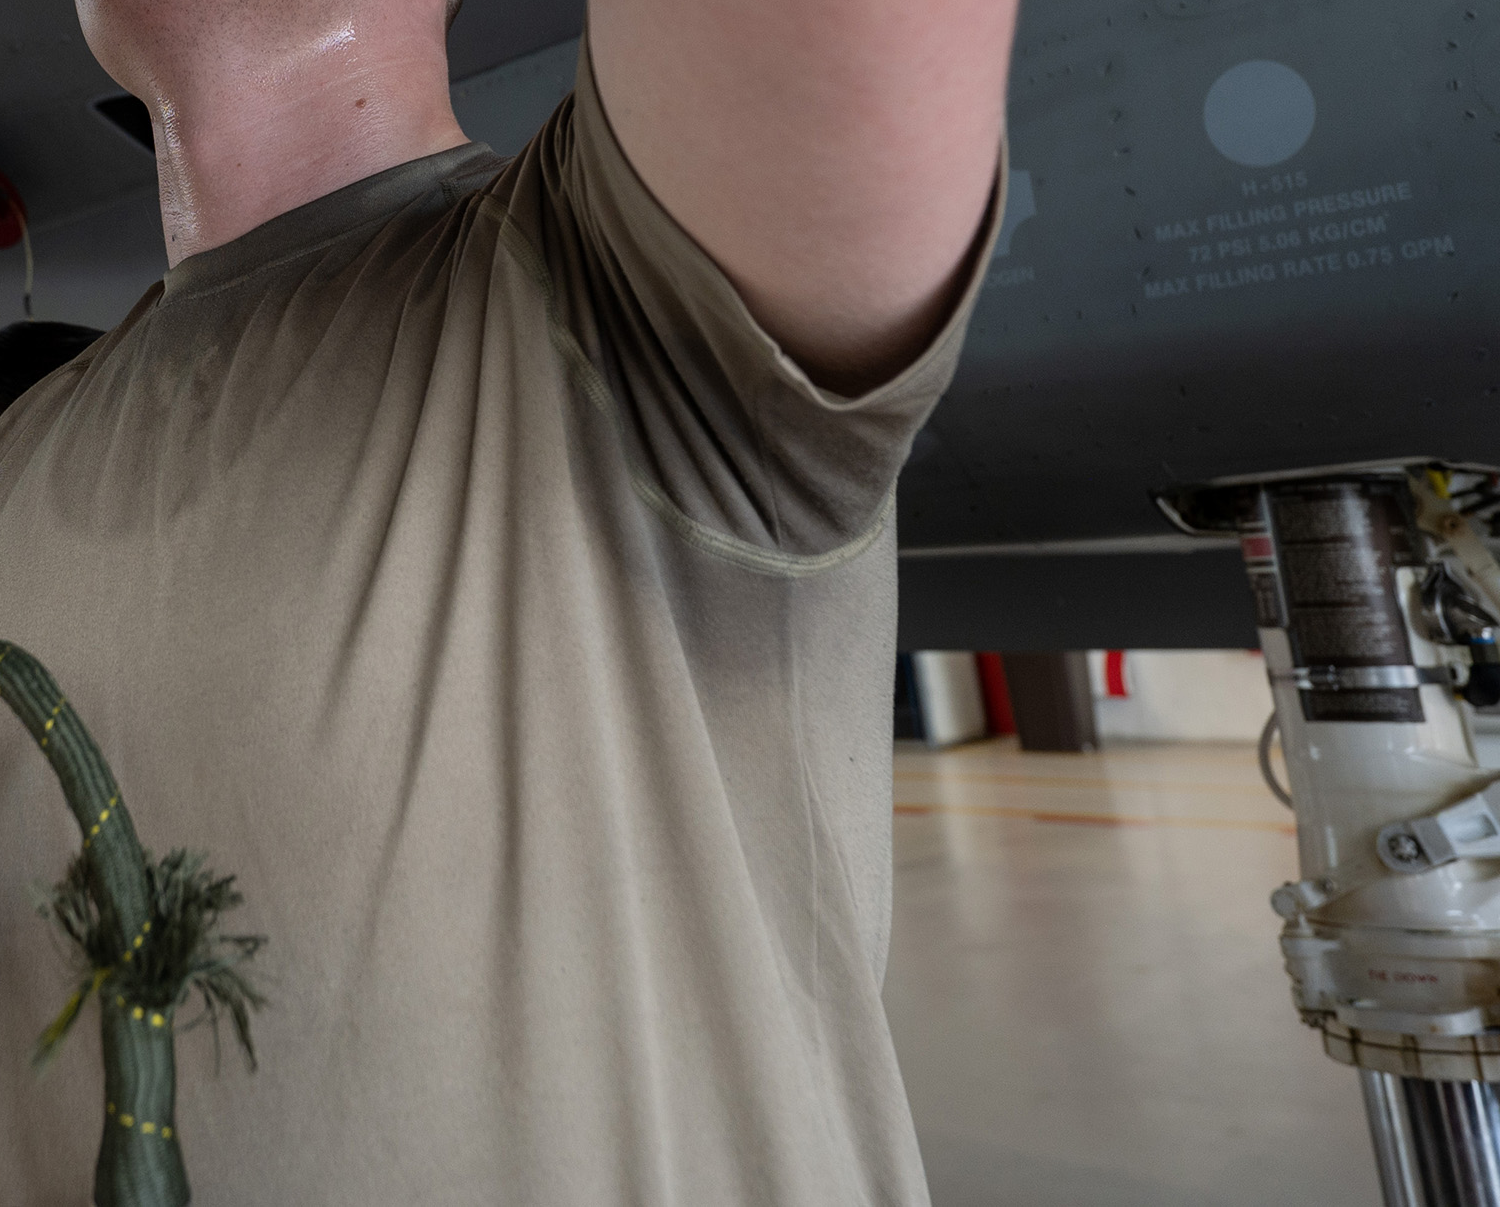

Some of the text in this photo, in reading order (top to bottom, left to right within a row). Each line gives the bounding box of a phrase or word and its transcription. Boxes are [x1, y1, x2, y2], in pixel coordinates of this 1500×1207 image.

[1242, 170, 1308, 195] H-515
[1155, 181, 1413, 242] MAX FILLING PRESSURE
[1144, 235, 1456, 300] MAX FILLING RATE 0.75 GPM
[1188, 243, 1213, 264] 72
[1217, 236, 1253, 259] PSI
